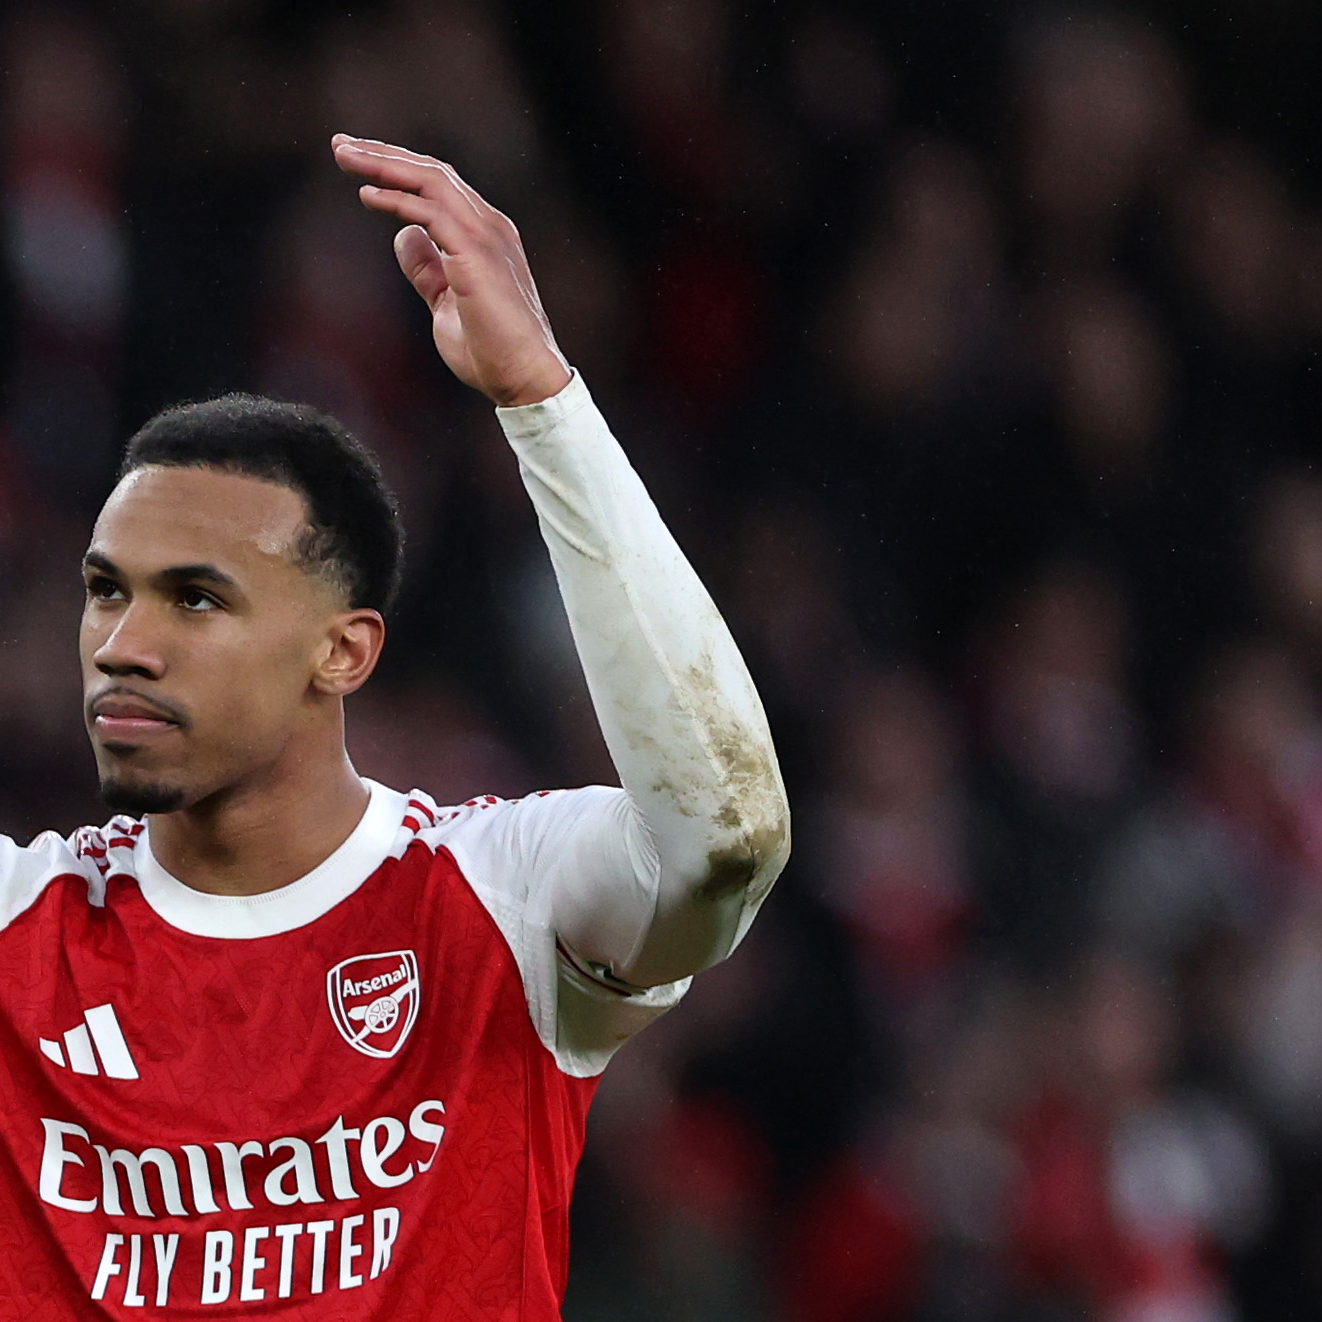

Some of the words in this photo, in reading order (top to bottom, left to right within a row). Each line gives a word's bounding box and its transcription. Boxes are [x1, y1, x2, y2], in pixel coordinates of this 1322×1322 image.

[342, 963, 407, 998] Arsenal
[39, 1100, 447, 1217] Emirates
[91, 1234, 180, 1307] FLY
[200, 1207, 401, 1306] BETTER
